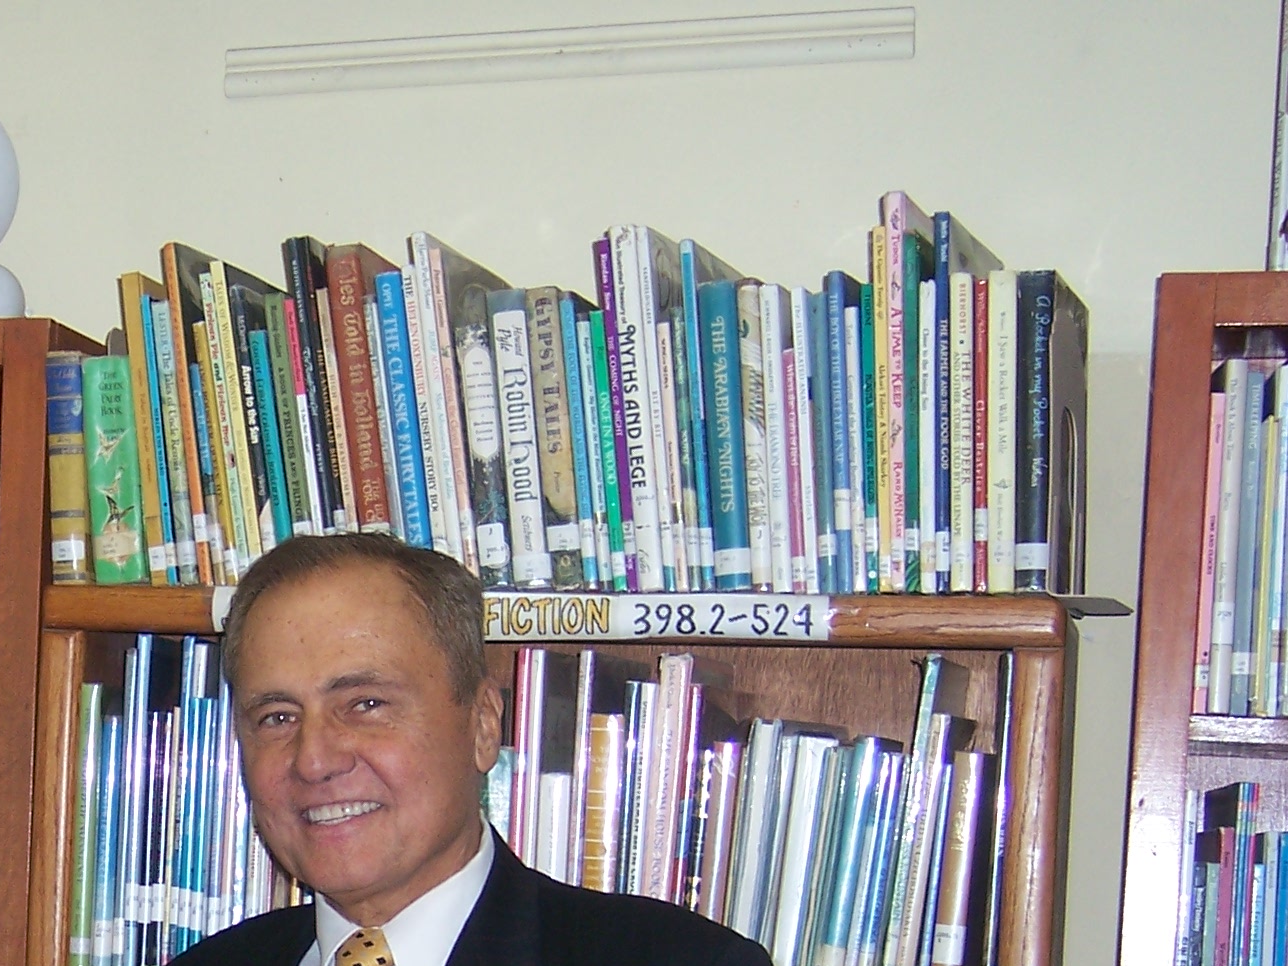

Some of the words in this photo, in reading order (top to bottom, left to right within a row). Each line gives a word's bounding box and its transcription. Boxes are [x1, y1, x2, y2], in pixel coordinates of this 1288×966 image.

[891, 234, 901, 265] TUDOR
[403, 276, 414, 299] THE
[1035, 295, 1048, 309] A
[407, 301, 420, 334] HELEN
[891, 307, 902, 318] A
[958, 283, 967, 335] BIERHORST
[383, 314, 400, 354] THE
[498, 328, 512, 353] Pyle
[512, 326, 525, 357] Howard
[534, 297, 559, 374] GYPSY
[607, 336, 615, 351] THE
[711, 317, 730, 354] THE
[891, 321, 903, 357] TIME
[940, 319, 948, 337] THE
[1031, 313, 1049, 353] Rocket
[162, 351, 173, 370] The
[410, 336, 426, 397] OXENBURY
[609, 355, 619, 392] COMING
[617, 325, 640, 394] MYTHS
[895, 360, 902, 370] TO
[940, 340, 949, 378] FARMER
[953, 352, 961, 371] AND
[961, 351, 971, 383] THE
[164, 372, 175, 395] Tales
[241, 365, 255, 395] Arrow
[389, 357, 410, 430] CLASSIC
[891, 373, 903, 409] KEEP
[940, 381, 948, 397] AND
[953, 374, 961, 402] OTHER
[1029, 375, 1043, 394] my
[166, 397, 177, 408] of
[245, 397, 256, 408] to
[502, 367, 529, 433] Robin
[599, 392, 612, 423] ONCE
[612, 396, 618, 405] OF
[714, 358, 731, 438] ARABIAN
[766, 402, 777, 422] THE
[940, 400, 948, 414] THE
[168, 409, 180, 436] Uncle
[246, 410, 258, 425] the
[417, 402, 432, 452] NURSERY
[541, 381, 564, 455] TALES
[602, 425, 612, 435] IN
[613, 410, 623, 437] NIGHT
[625, 400, 642, 438] AND
[940, 417, 949, 444] POOR
[953, 408, 962, 442] STORIES
[962, 388, 971, 442] WHITE
[975, 400, 984, 436] Clever
[1032, 398, 1046, 440] Pocket
[248, 426, 260, 444] Sun
[603, 438, 613, 447] A
[768, 425, 779, 474] DIAMOND
[171, 439, 182, 471] Remus
[396, 434, 416, 487] FAIRY
[604, 450, 616, 484] WOOD
[940, 447, 949, 469] GOD
[953, 445, 962, 470] TOLD
[962, 447, 971, 485] DEER
[975, 442, 985, 492] Beatrice
[422, 456, 437, 492] STORY
[509, 440, 538, 503] Hood
[717, 442, 734, 512] NIGHTS
[893, 462, 903, 490] RAND
[953, 471, 962, 481] BY
[771, 477, 781, 500] TREE
[953, 485, 962, 503] THE
[402, 491, 423, 545] TALES
[952, 504, 962, 537] LENAPE
[633, 602, 814, 636] 398.2-524
